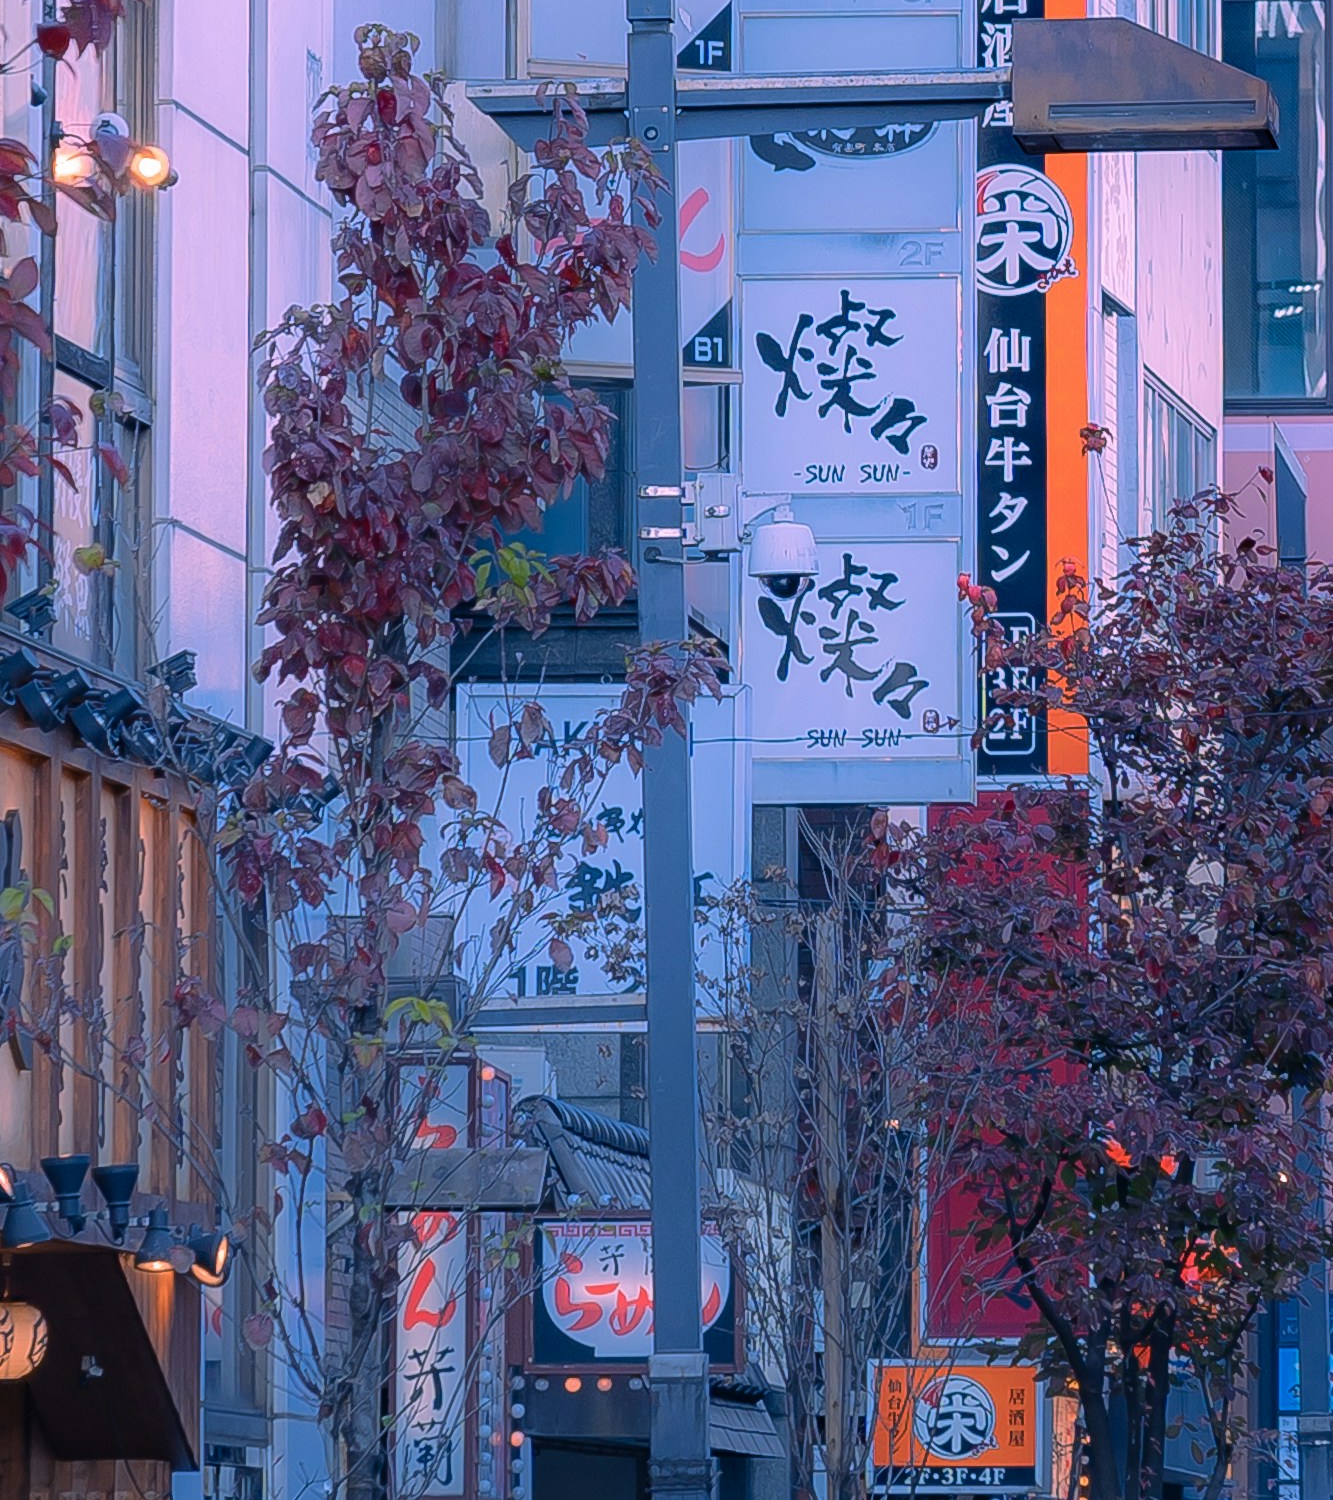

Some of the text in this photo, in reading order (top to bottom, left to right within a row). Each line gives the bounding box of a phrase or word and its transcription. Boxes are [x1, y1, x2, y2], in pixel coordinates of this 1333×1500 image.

[695, 39, 725, 66] 1F
[900, 240, 945, 267] 2F
[695, 336, 724, 363] B1
[984, 326, 1033, 583] 仙台牛タン
[905, 503, 944, 531] 1F
[1008, 1388, 1025, 1447] 居酒屋
